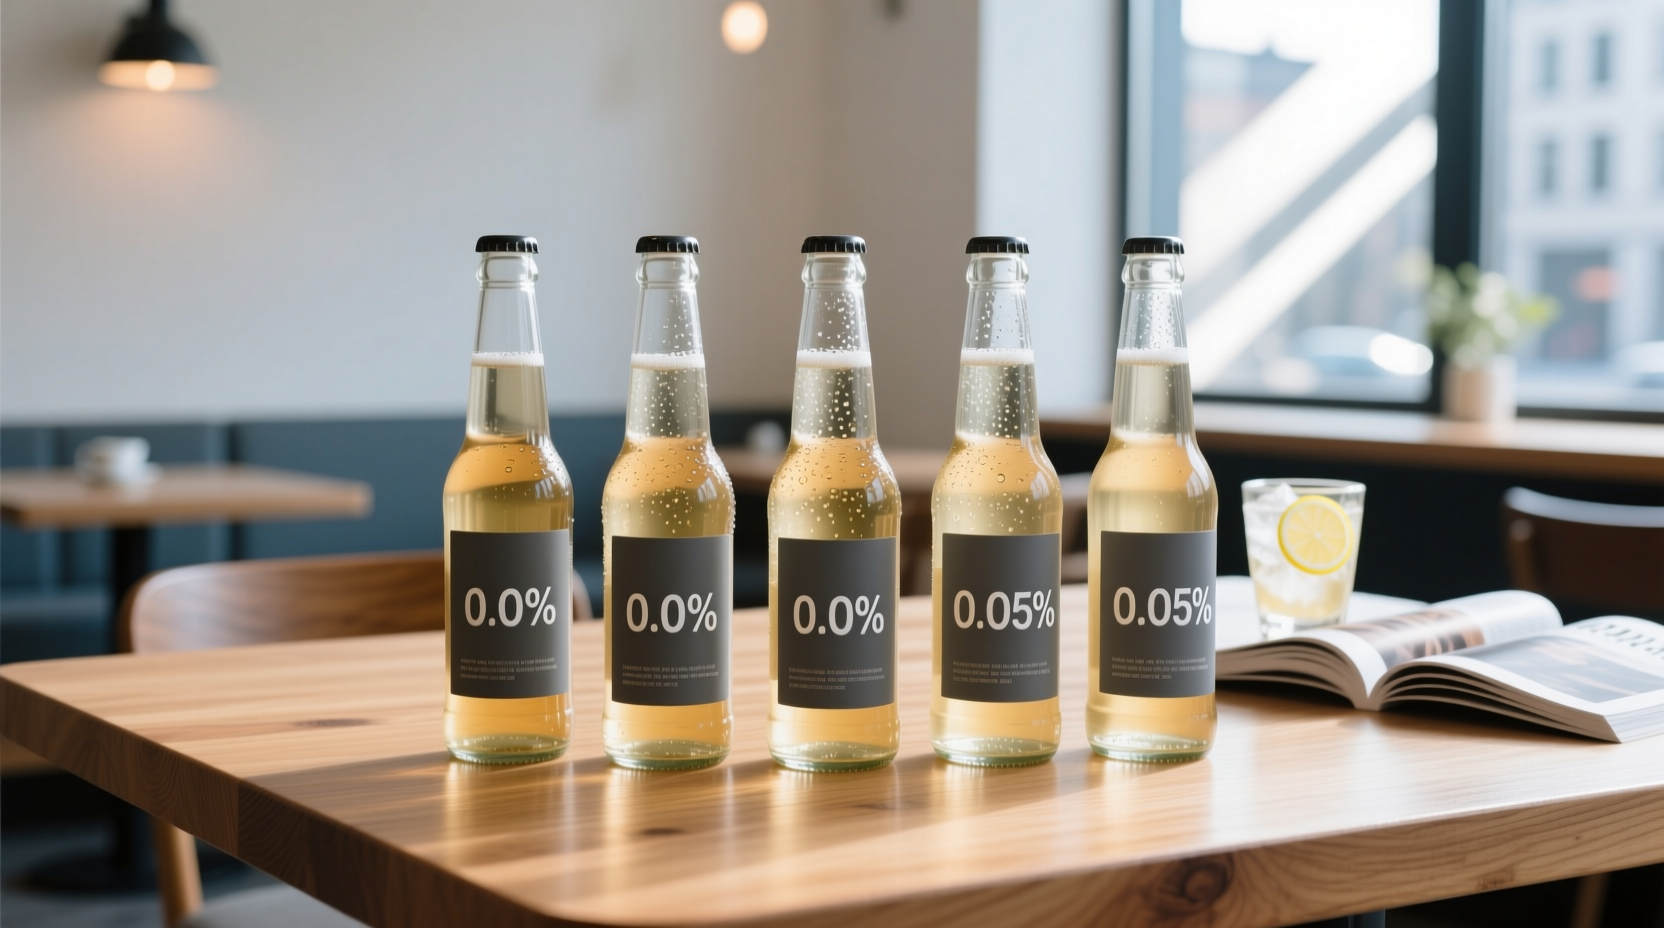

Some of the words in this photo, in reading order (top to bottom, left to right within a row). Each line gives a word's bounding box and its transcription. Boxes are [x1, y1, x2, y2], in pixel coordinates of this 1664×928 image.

[464, 586, 557, 627] 0.0%
[626, 592, 718, 634] 0.0%
[793, 594, 885, 636] 0.0%
[953, 589, 1055, 630] 0.05%
[1113, 585, 1212, 627] 0.05%
